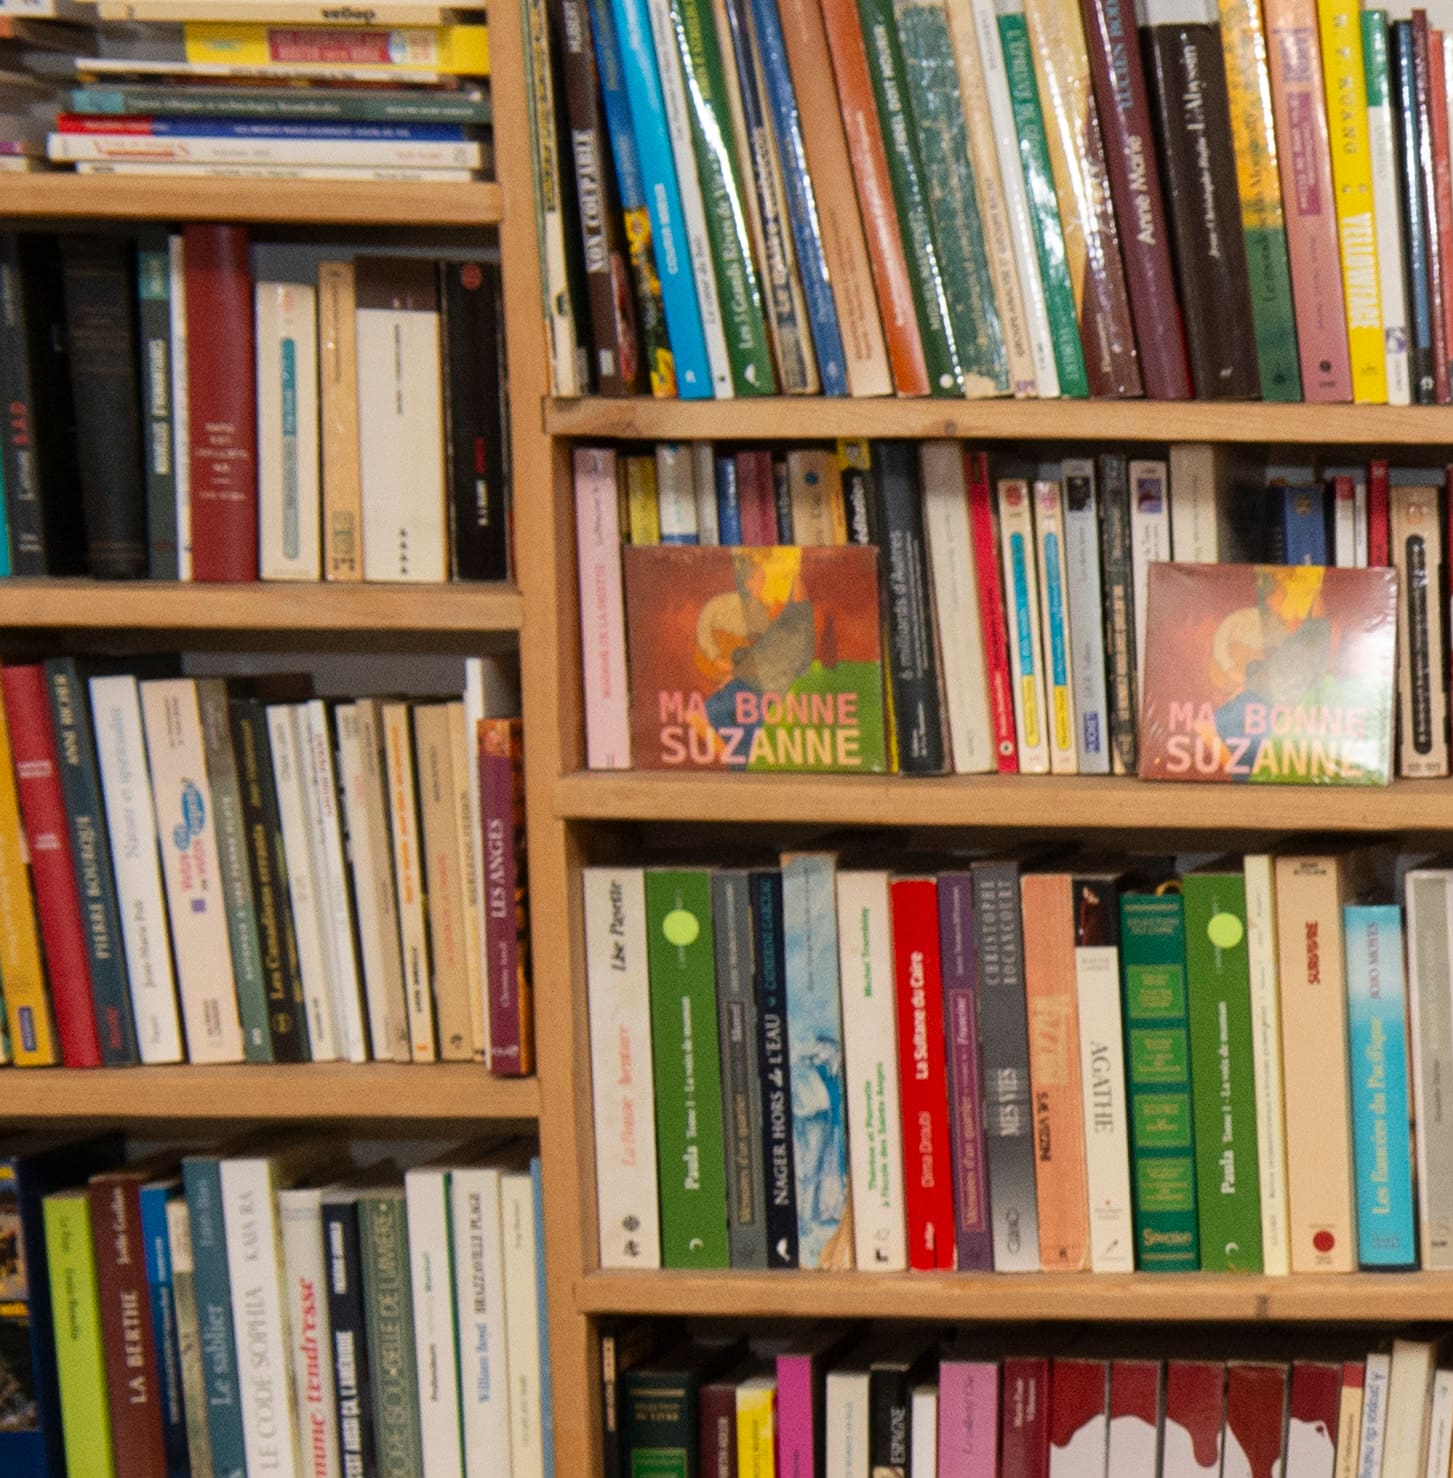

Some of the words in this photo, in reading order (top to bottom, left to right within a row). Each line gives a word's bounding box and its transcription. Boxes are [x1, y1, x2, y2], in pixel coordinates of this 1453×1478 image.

[1126, 135, 1149, 190] Marie
[660, 691, 706, 722] MA
[737, 693, 858, 722] BONNE
[1170, 702, 1216, 732] MA
[660, 730, 859, 765] SUZANNE
[487, 818, 505, 880] ANGES
[490, 885, 506, 919] LES
[609, 880, 625, 937] Payette
[87, 903, 111, 959] PIERRE
[981, 880, 998, 985] CHRISTOPHE
[612, 945, 627, 971] Lise
[910, 952, 923, 987] Caire
[912, 989, 924, 1005] du
[765, 1014, 782, 1063] L'EAU
[914, 1008, 927, 1061] Sultane
[916, 1063, 928, 1079] La
[998, 1068, 1018, 1101] VIES
[1089, 1042, 1113, 1134] AGATHE
[771, 1091, 786, 1138] HORS
[1000, 1105, 1020, 1136] MES
[773, 1143, 790, 1205] NAGER
[120, 1289, 142, 1367] BERTHE
[203, 1303, 230, 1375] sablier
[245, 1287, 272, 1368] SOPHIA
[298, 1277, 324, 1403] tendresse
[129, 1376, 148, 1403] LA
[210, 1378, 232, 1406] Le
[253, 1372, 276, 1439] CODE
[258, 1443, 280, 1470] LE
[891, 1406, 905, 1463] ESPAGNE
